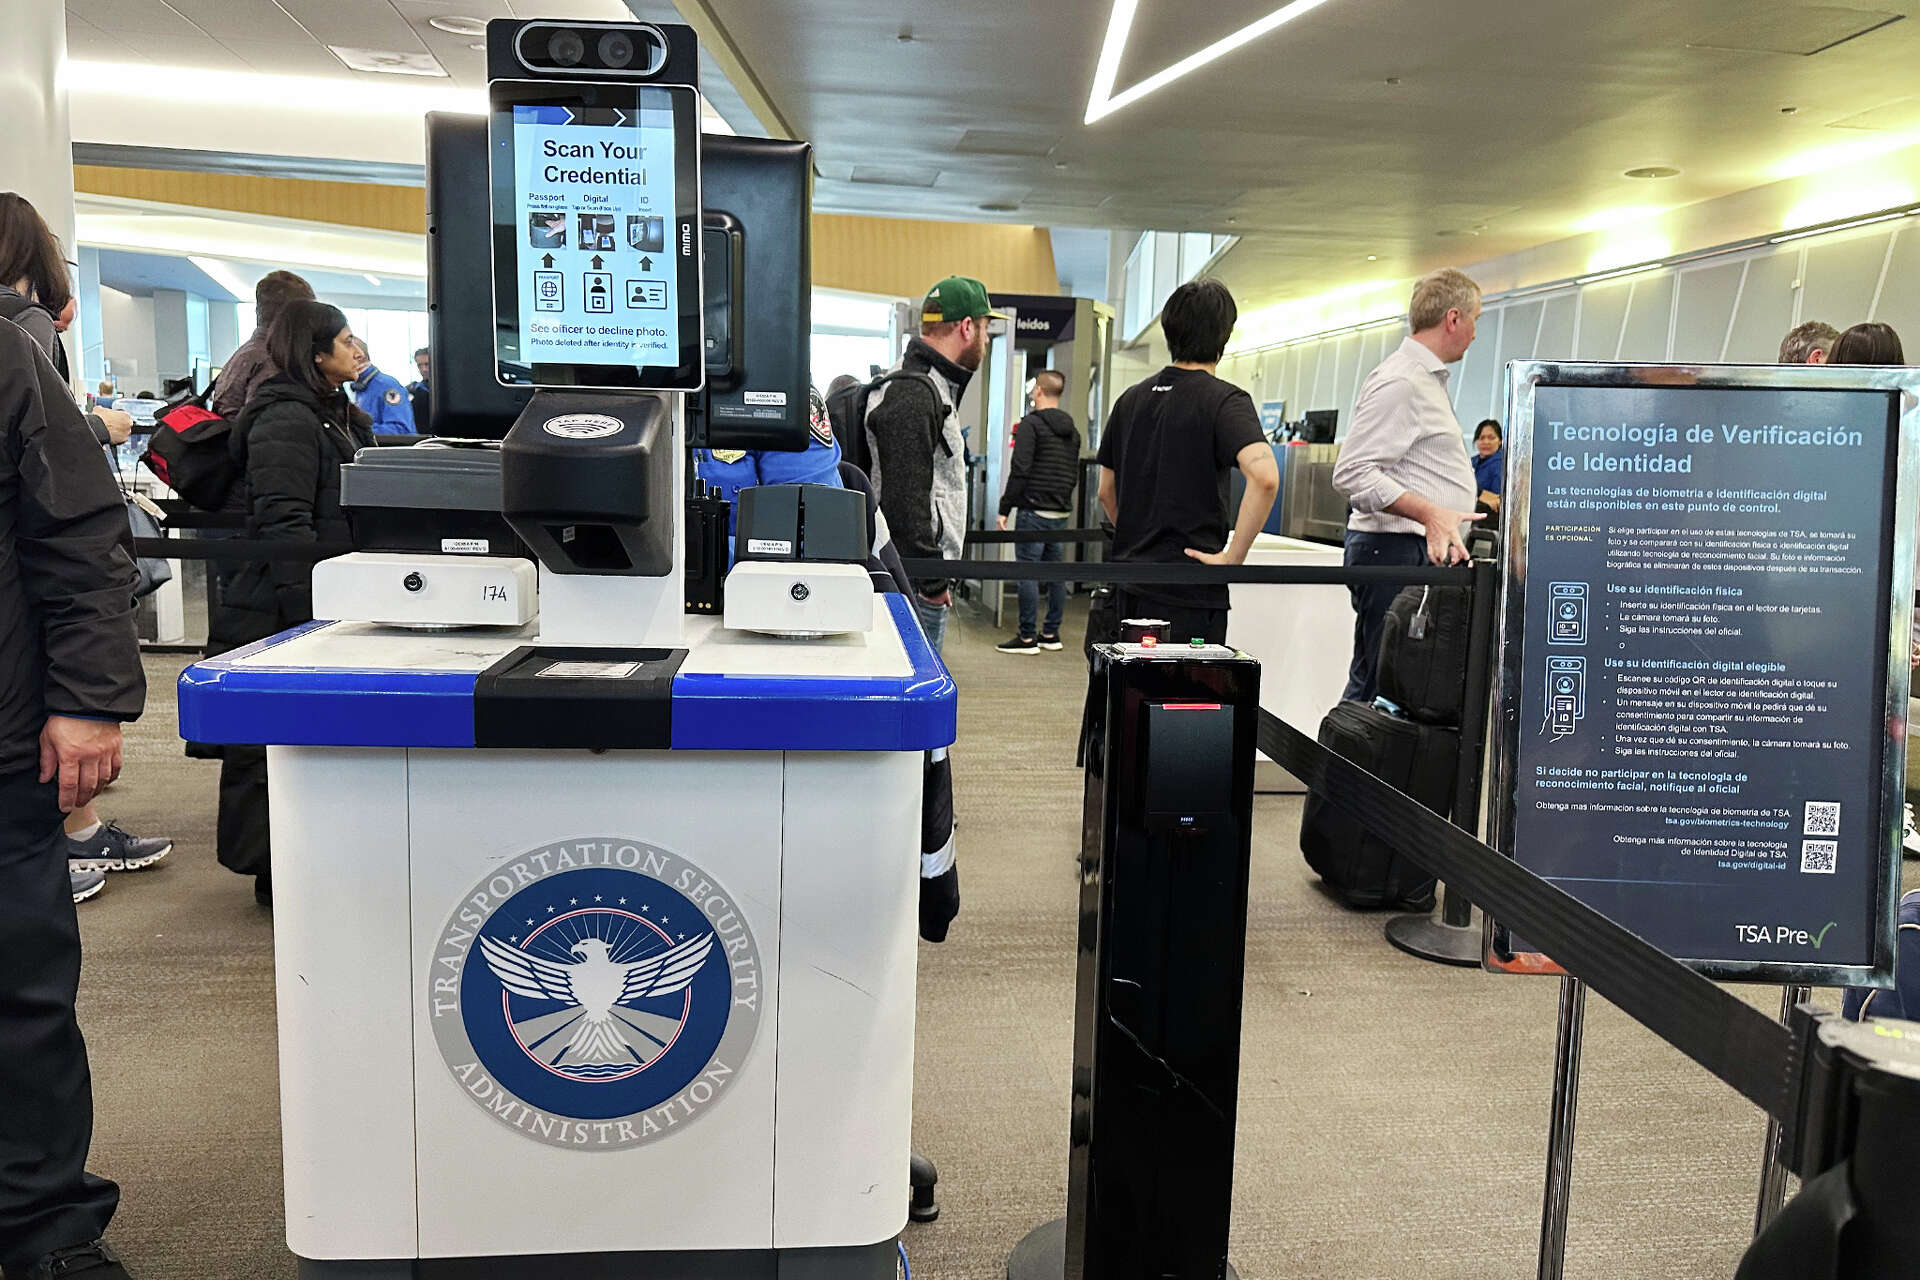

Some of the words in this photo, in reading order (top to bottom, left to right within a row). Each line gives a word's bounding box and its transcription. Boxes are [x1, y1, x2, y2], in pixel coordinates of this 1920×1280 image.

[543, 140, 594, 158] Scan
[600, 141, 648, 160] Your
[544, 165, 647, 185] Credential
[528, 192, 565, 202] Passport
[583, 195, 608, 204] Digital
[682, 223, 691, 256] mimo
[531, 324, 549, 333] See
[552, 325, 584, 334] officer
[586, 326, 596, 334] to
[599, 326, 634, 336] decline
[636, 327, 668, 338] photo.
[1017, 318, 1050, 330] leidos
[531, 338, 553, 346] Photo
[1549, 422, 1678, 446] Tecnología
[1686, 424, 1714, 443] de
[1722, 425, 1862, 445] Verificación
[1548, 452, 1576, 471] de
[1584, 453, 1692, 473] Identidad
[1546, 485, 1567, 496] Las
[1570, 486, 1633, 499] tecnologías
[1636, 488, 1650, 498] de
[1707, 491, 1714, 499] e
[1717, 489, 1790, 500] identificación
[1793, 490, 1827, 502] digital
[1547, 500, 1578, 508] están
[1579, 499, 1642, 510] disponibles
[1645, 502, 1659, 510] en
[1662, 502, 1685, 510] este
[1688, 503, 1720, 512] punto
[1723, 502, 1736, 512] de
[1739, 504, 1781, 513] control.
[484, 586, 507, 602] 174
[1607, 584, 1627, 593] Use
[1645, 585, 1713, 595] identificación
[1605, 658, 1624, 667] Use
[1627, 660, 1639, 668] su
[1642, 659, 1710, 669] identificación
[1712, 661, 1744, 672] digital
[1746, 662, 1786, 673] elegible
[1559, 714, 1570, 722] ID
[1536, 766, 1546, 775] Si
[1549, 767, 1582, 776] decide
[1586, 769, 1598, 777] no
[1601, 770, 1650, 779] participar
[1668, 770, 1676, 779] la
[1735, 773, 1748, 782] de
[1536, 780, 1614, 789] reconocimiento
[1617, 781, 1647, 790] facial,
[1650, 783, 1695, 792] notifique
[1698, 784, 1706, 792] al
[1709, 784, 1740, 793] oficial
[434, 843, 670, 1016] TRANSPORTATION
[674, 868, 757, 1012] SECURITY
[1736, 925, 1772, 943] TSA
[1776, 926, 1808, 944] Pre
[453, 1058, 734, 1144] ADMINISTRATION
